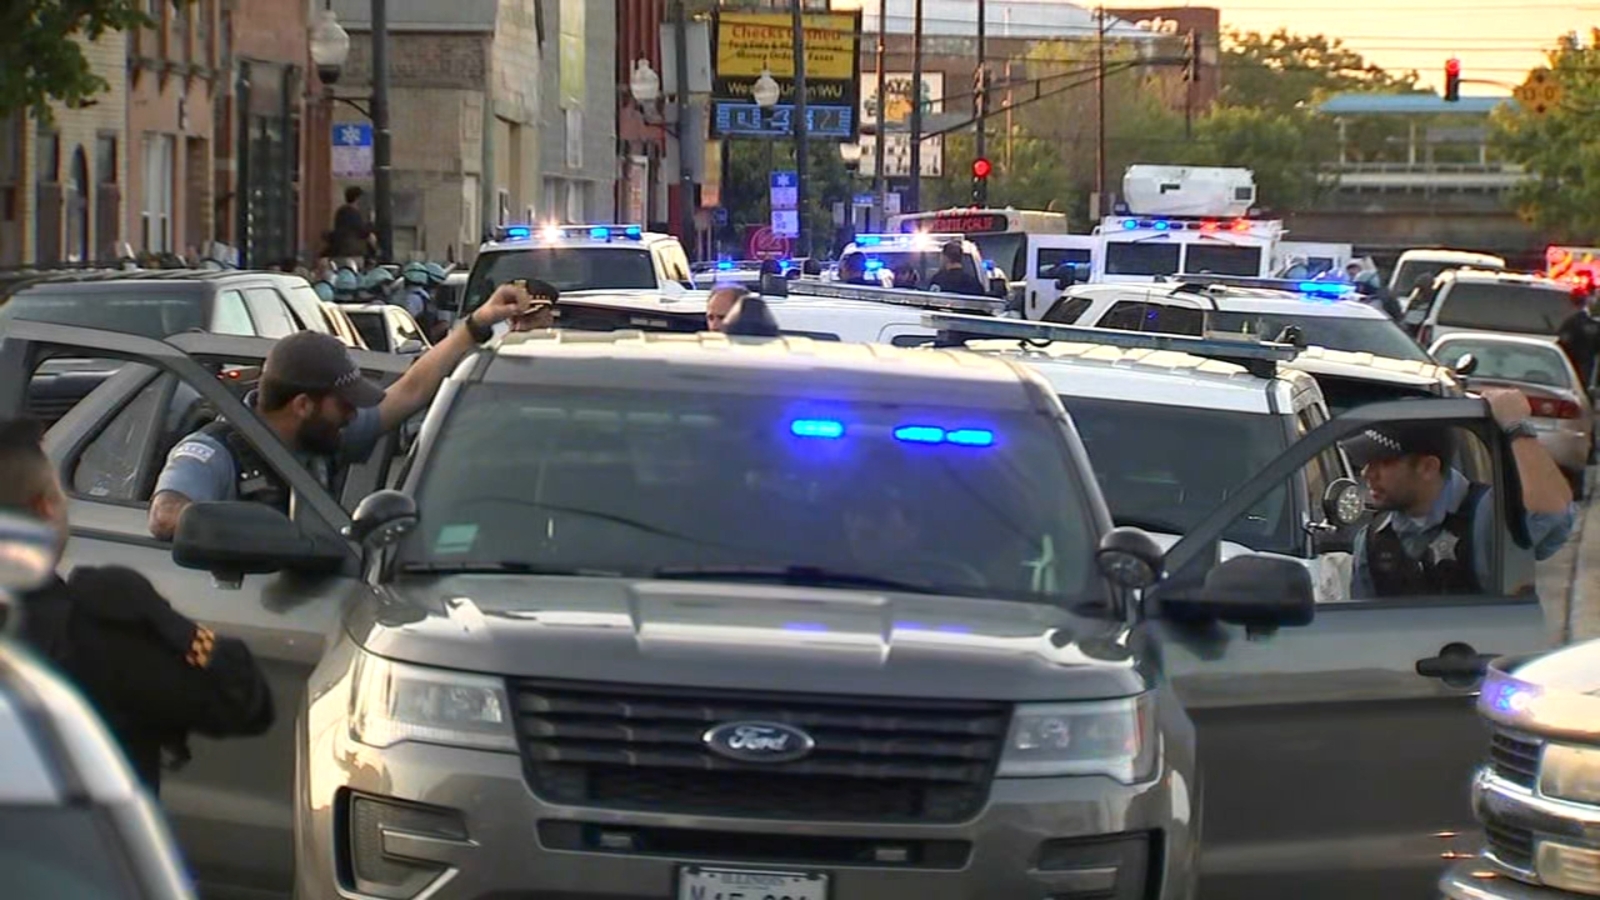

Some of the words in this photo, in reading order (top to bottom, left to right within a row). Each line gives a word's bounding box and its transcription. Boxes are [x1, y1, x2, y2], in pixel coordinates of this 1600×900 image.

[731, 24, 787, 39] Checks
[788, 27, 841, 41] Cshed
[728, 726, 789, 751] Ford
